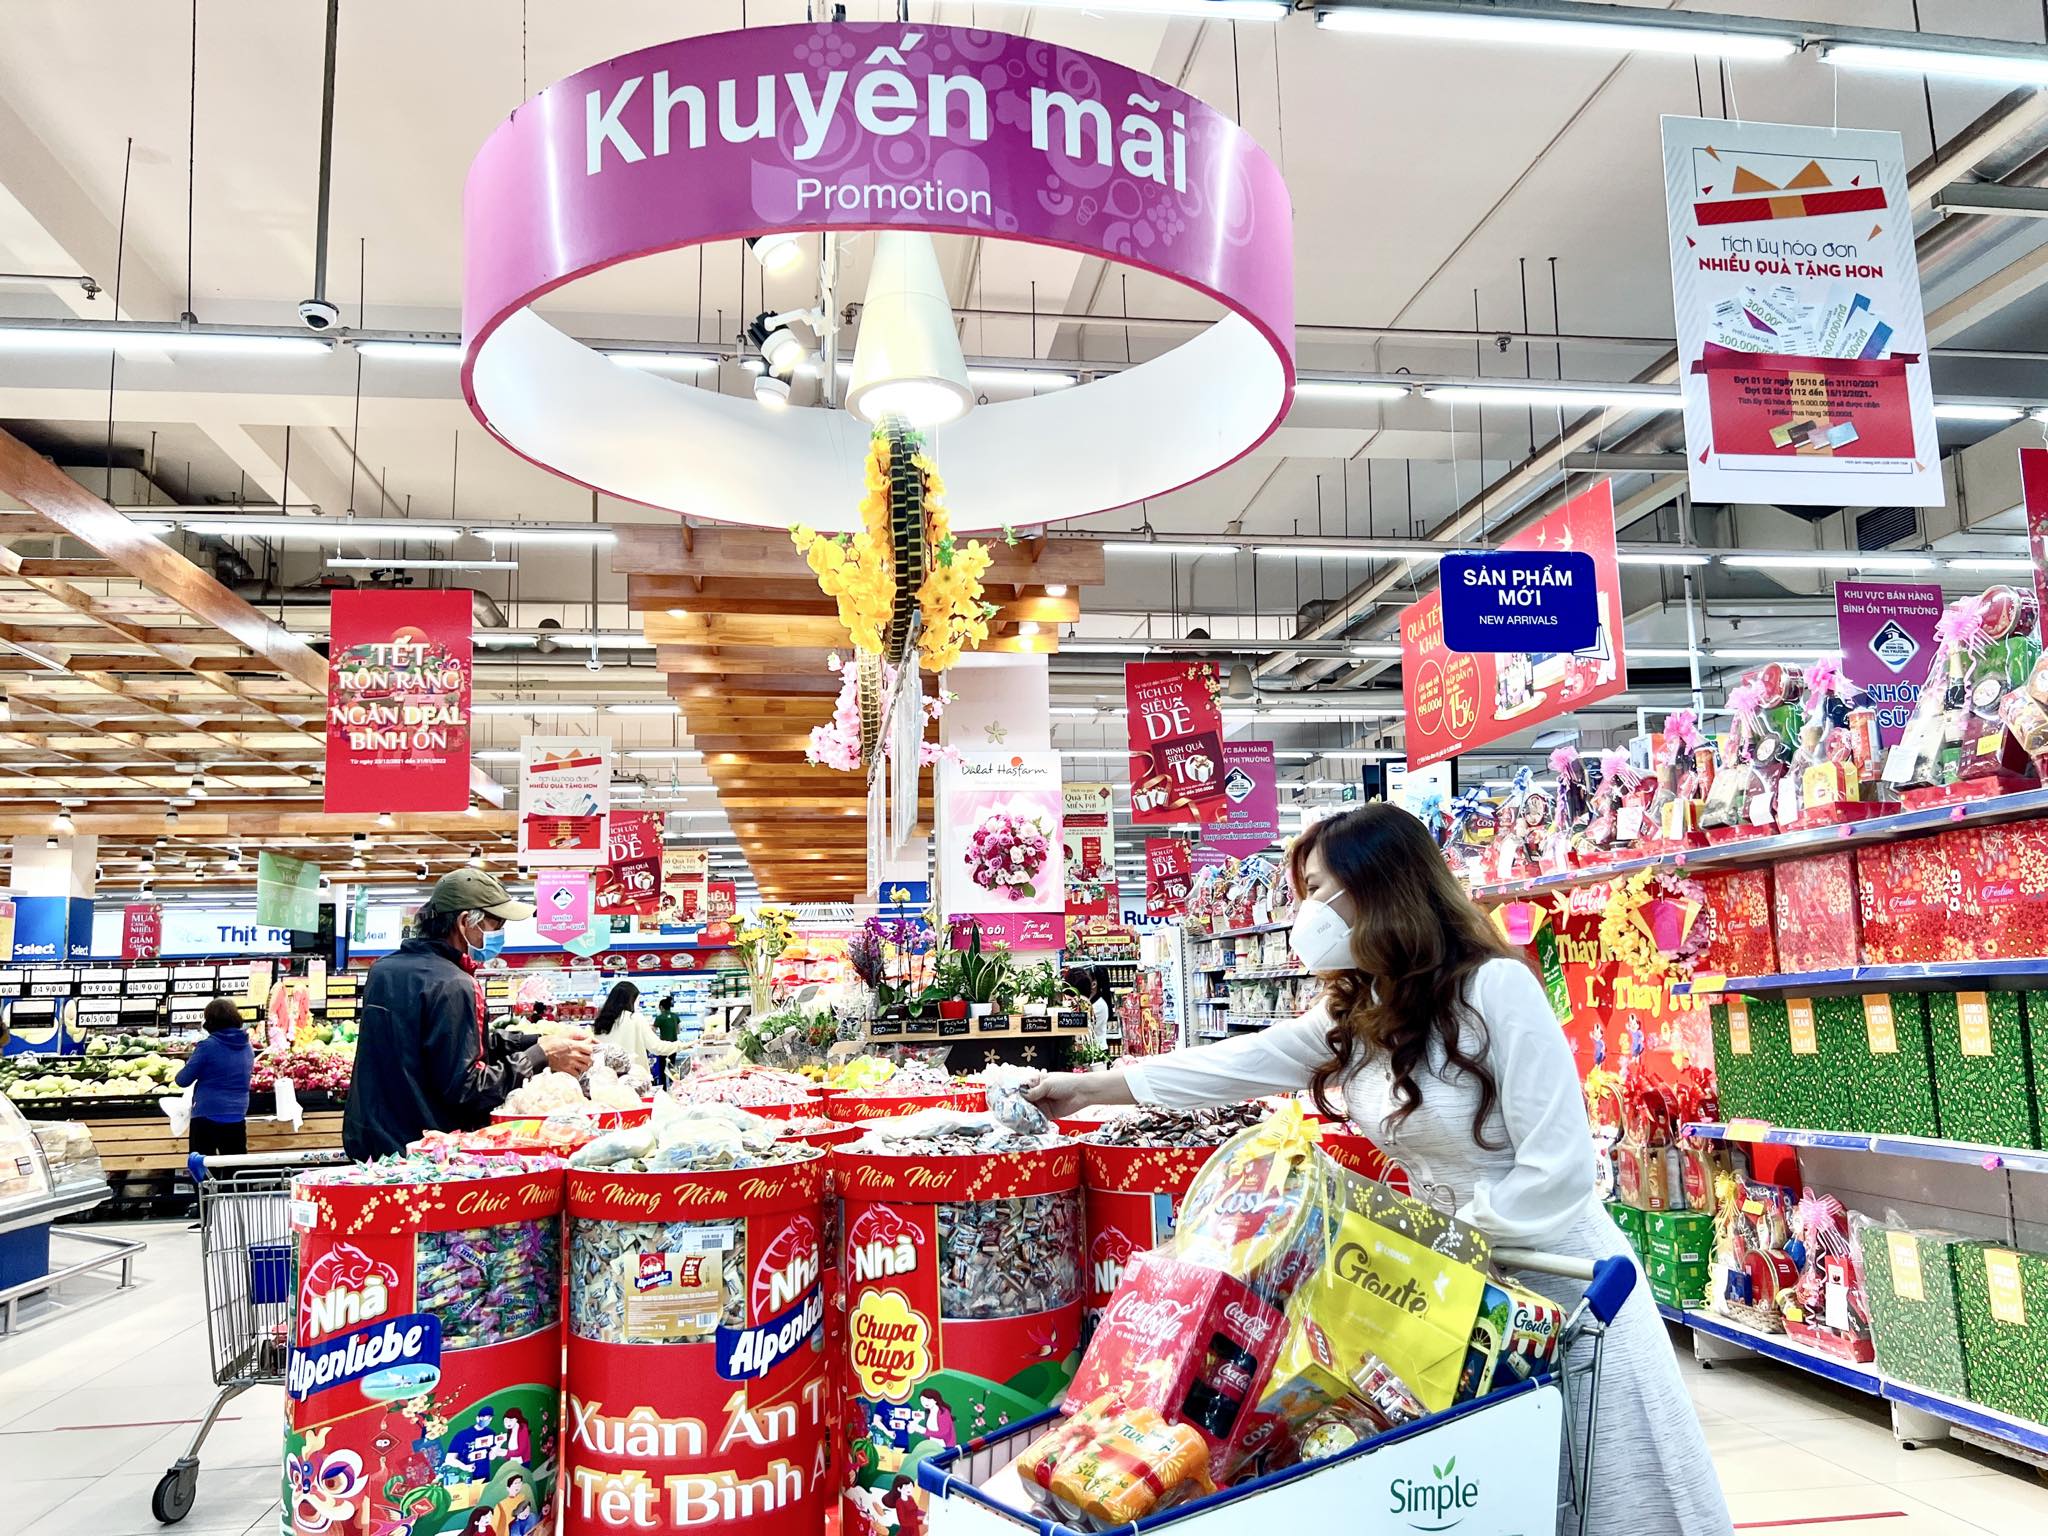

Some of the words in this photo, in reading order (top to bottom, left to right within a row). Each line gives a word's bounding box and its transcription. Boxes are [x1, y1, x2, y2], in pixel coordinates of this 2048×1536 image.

[585, 33, 990, 176] Khuyến
[1031, 90, 1187, 194] mãi
[796, 177, 992, 216] Promotion
[1721, 236, 1752, 253] tích
[1822, 242, 1857, 258] đơn
[1699, 252, 1750, 273] NHIỀU
[1754, 258, 1791, 275] QUÀ
[1794, 260, 1841, 280] TẶNG
[1845, 264, 1883, 278] HƠN
[1463, 566, 1507, 586] SẢN
[1512, 564, 1573, 586] PHẨM
[1498, 586, 1541, 606] MỚI
[1844, 590, 1864, 600] KHU
[1865, 590, 1885, 600] VỰC
[1886, 589, 1906, 600] BÁN
[1907, 590, 1934, 601] HÀNG
[1479, 615, 1505, 625] NEW
[1506, 615, 1558, 625] ARRIVALS
[1843, 604, 1865, 614] BÌNH
[1866, 601, 1880, 614] ỔN
[1881, 606, 1897, 617] THỊ
[1897, 604, 1939, 616] TRƯỜNG
[371, 636, 430, 667] TẾT
[339, 667, 389, 692] RỘN
[395, 668, 461, 690] RÀNG
[1136, 688, 1162, 700] TÍCH
[1163, 683, 1184, 695] LŨY
[331, 702, 399, 725] NGÀN
[403, 706, 467, 725] DEAL
[1141, 698, 1173, 715] SIÊU
[1142, 697, 1195, 740] DỄ
[1449, 689, 1474, 730] 15%
[350, 728, 407, 751] BÌNH
[413, 724, 447, 750] ỔN
[997, 764, 1048, 776] Hasfarm
[217, 926, 257, 946] Thịt
[963, 927, 984, 935] HA
[987, 926, 1005, 935] GÓI
[14, 943, 55, 955] Select
[71, 944, 88, 956] Select
[857, 1164, 895, 1188] Năm
[904, 1166, 956, 1189] Mới
[456, 1191, 510, 1215] Chúc
[570, 1180, 597, 1204] Chúc
[602, 1183, 663, 1214] Mừng
[673, 1182, 728, 1205] Năm
[739, 1177, 788, 1200] Mới
[855, 1235, 917, 1282] Nhà
[770, 1243, 820, 1313] Nhà
[1094, 1258, 1123, 1295] Nh
[310, 1275, 388, 1339] Nhà
[857, 1314, 918, 1348] Chupa
[288, 1323, 423, 1402] Alpenliebe
[855, 1341, 916, 1385] Chups
[571, 1397, 702, 1457] Xuân
[1242, 1422, 1275, 1447] COSY
[576, 1470, 657, 1527] Tết
[671, 1462, 802, 1526] Bình
[1390, 1475, 1479, 1520] Simple
